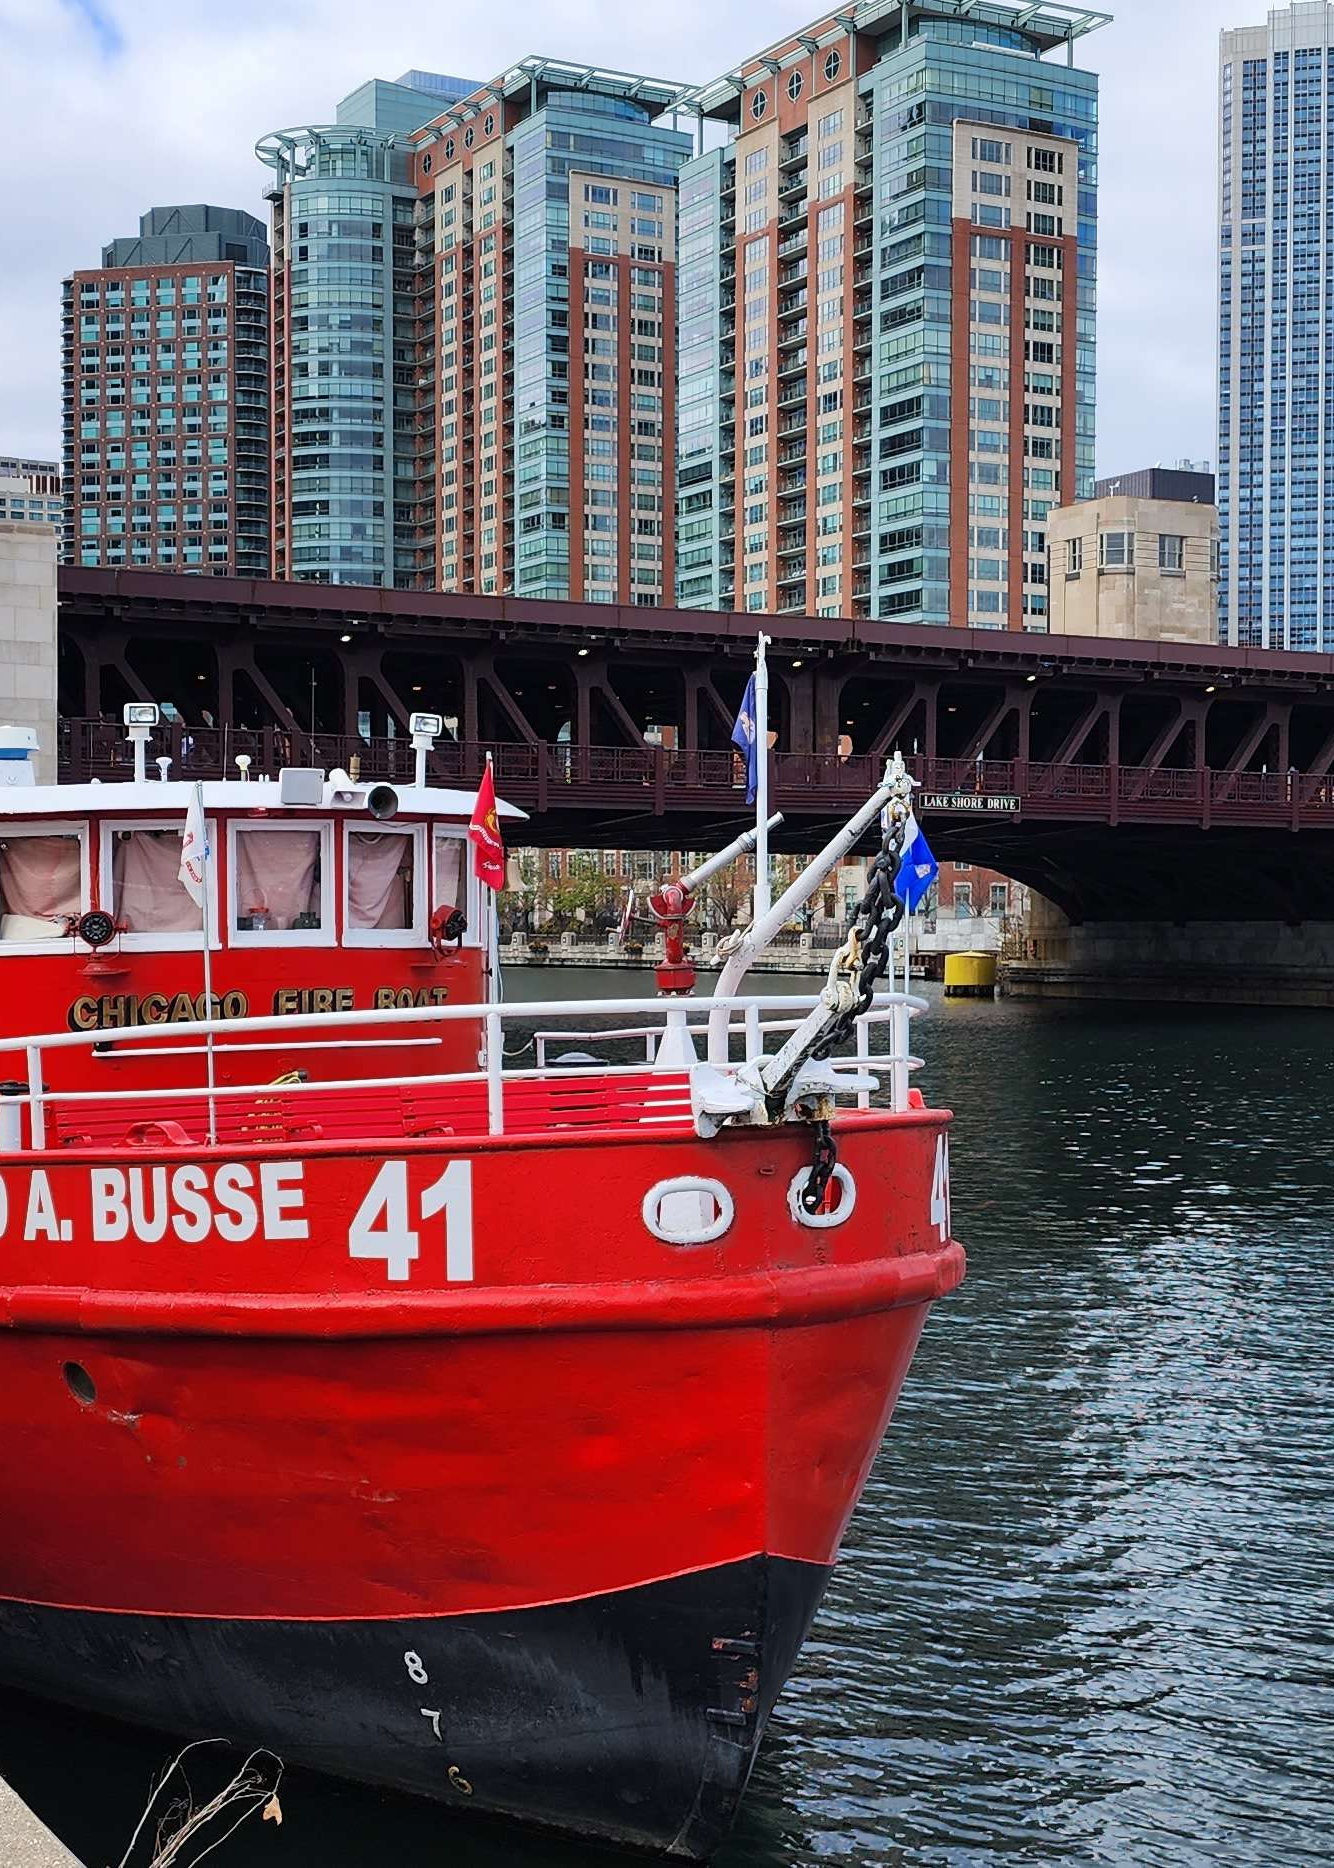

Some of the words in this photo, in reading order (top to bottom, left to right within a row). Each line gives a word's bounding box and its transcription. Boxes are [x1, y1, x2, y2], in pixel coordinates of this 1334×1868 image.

[924, 795, 949, 808] LAKE
[951, 796, 984, 809] SHORE
[987, 798, 1016, 810] DRIVE
[69, 990, 248, 1031] CHICAGO
[272, 988, 354, 1016] FIRE
[373, 987, 450, 1019] BOAT
[23, 1169, 73, 1242] A.
[90, 1161, 310, 1242] BUSSE
[348, 1160, 474, 1282] 41
[404, 1650, 428, 1685] 8
[420, 1707, 443, 1742] 7
